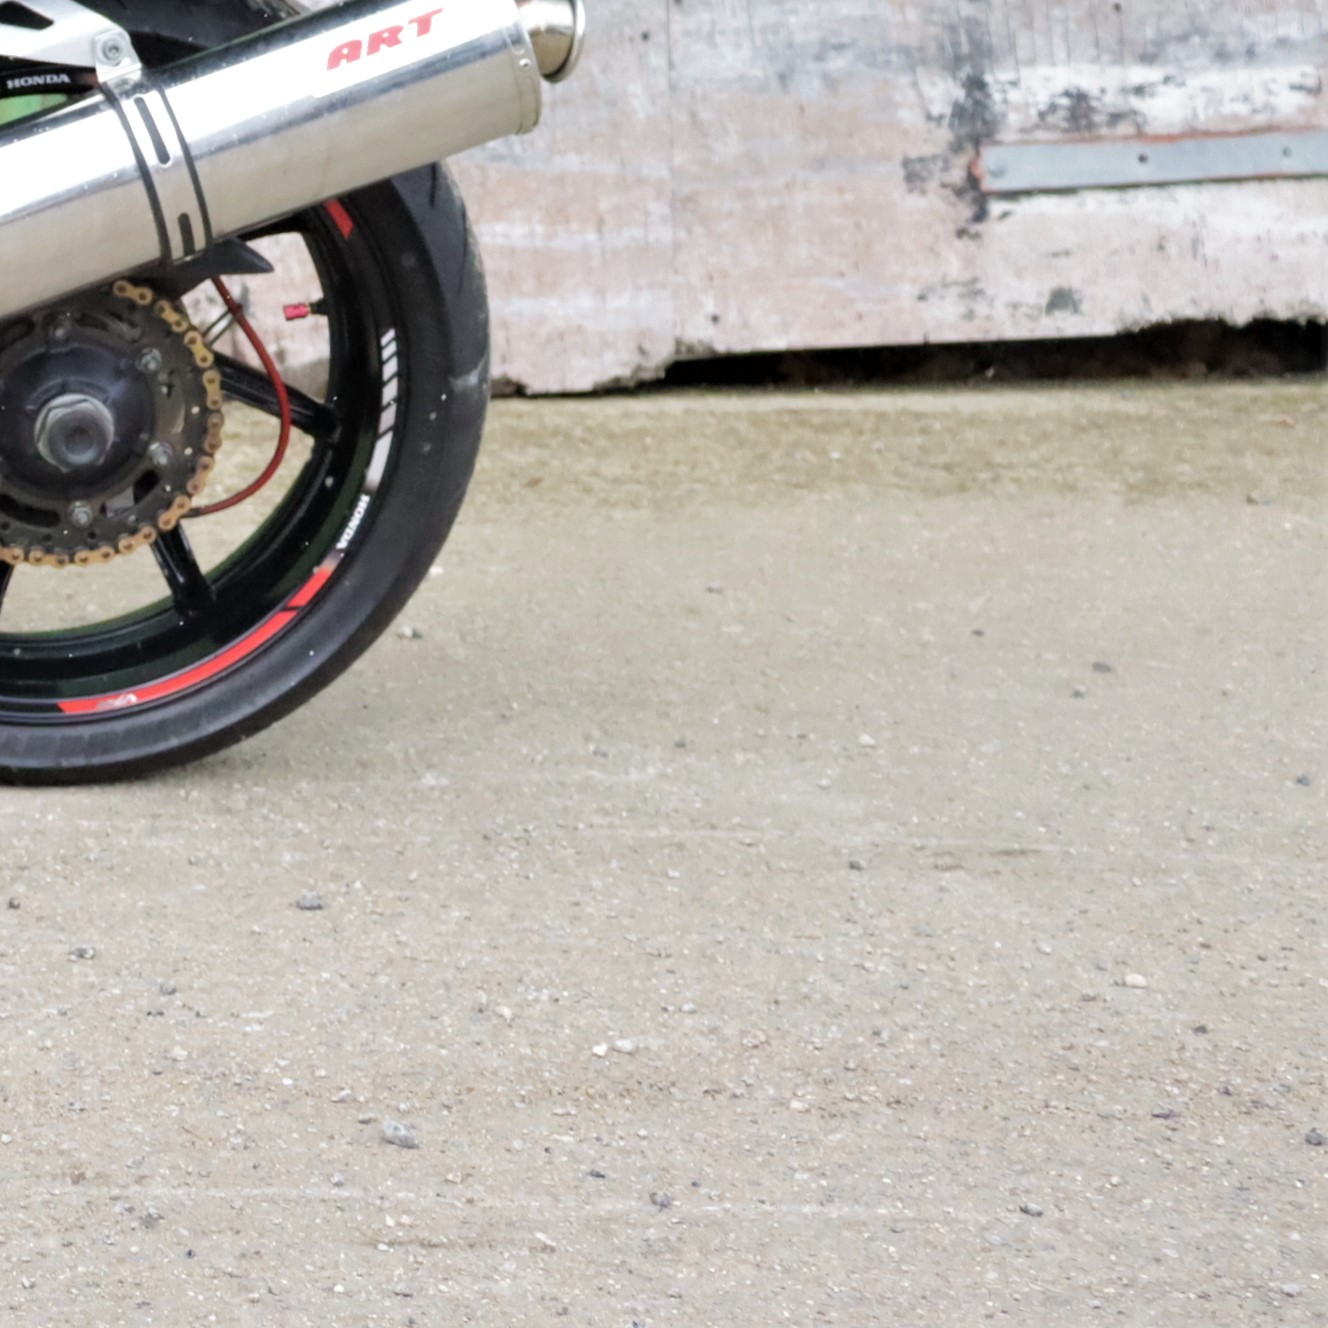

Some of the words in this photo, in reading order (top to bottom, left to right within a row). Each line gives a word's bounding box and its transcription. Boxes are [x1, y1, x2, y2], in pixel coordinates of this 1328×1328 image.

[326, 7, 444, 71] ART
[6, 73, 71, 90] HONDA
[335, 494, 371, 550] HONDA
